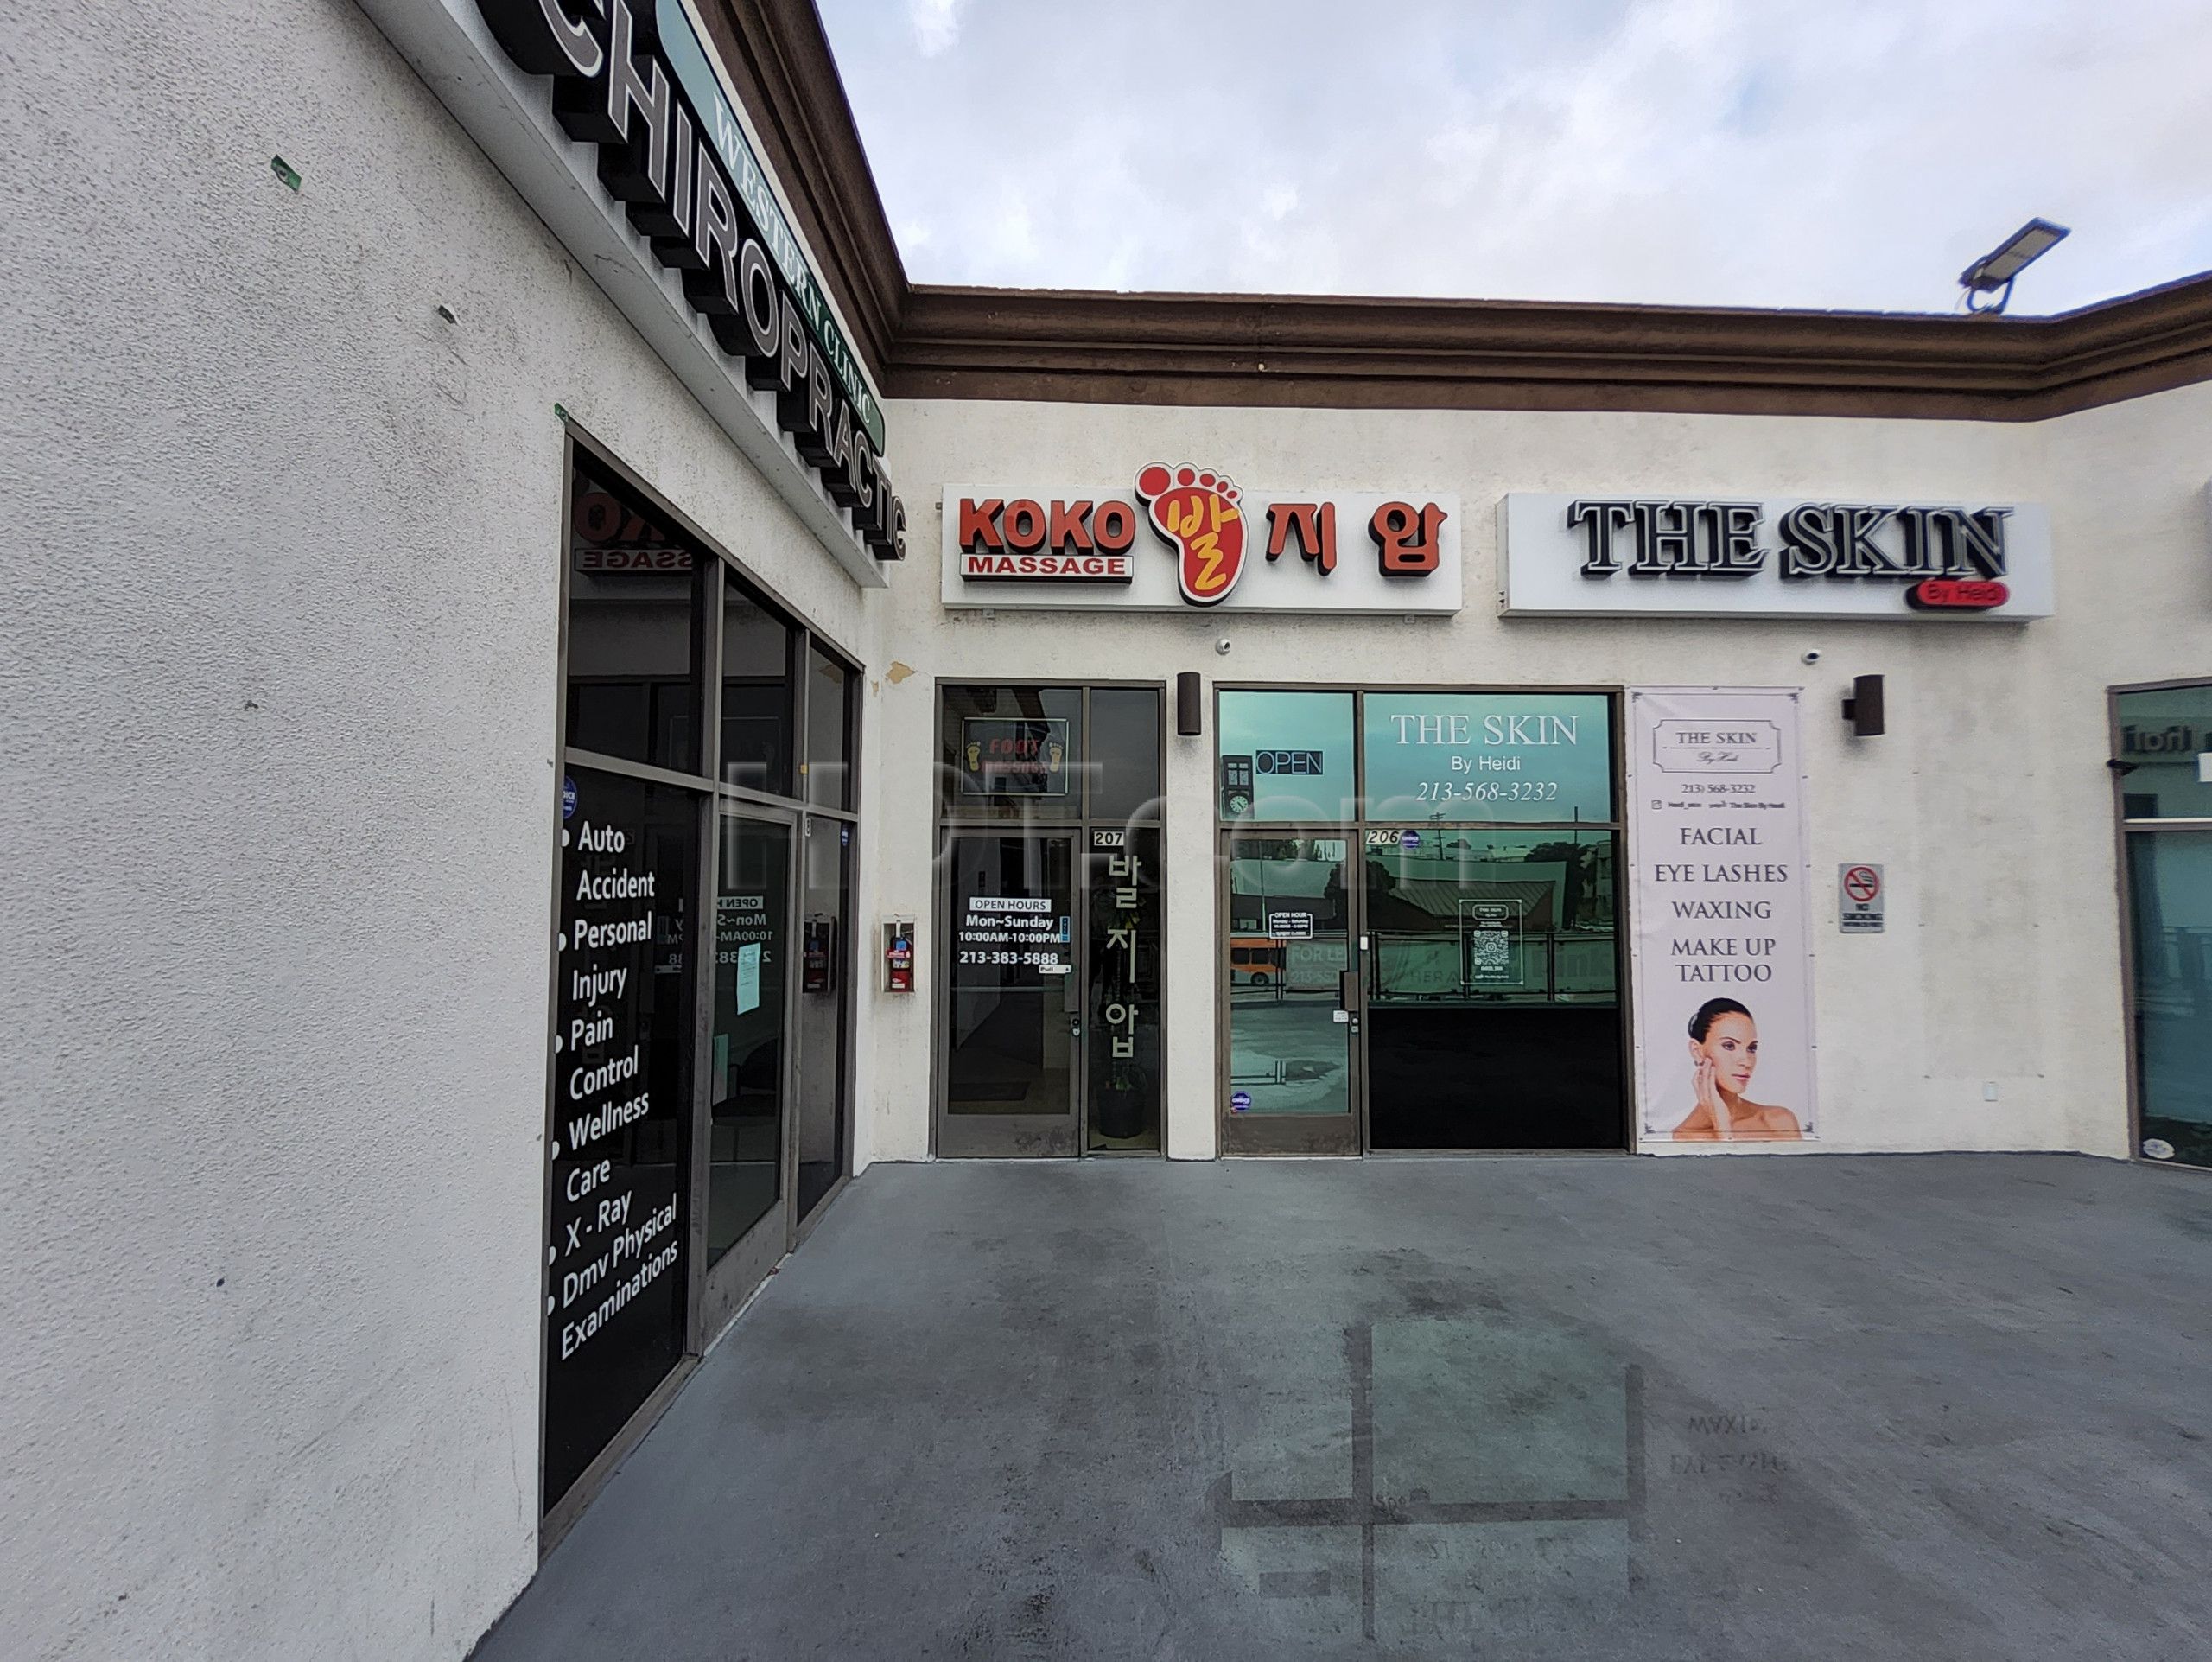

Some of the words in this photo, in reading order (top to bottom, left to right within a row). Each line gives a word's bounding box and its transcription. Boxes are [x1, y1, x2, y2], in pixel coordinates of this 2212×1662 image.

[713, 92, 823, 334] WESTERN
[823, 320, 872, 425] CLINIC
[958, 498, 1137, 556] KOKO
[1567, 498, 1770, 580] THE
[1777, 501, 2015, 582] SKIN
[967, 557, 1126, 576] MASSAGE
[1390, 714, 1471, 746] THE
[1484, 714, 1580, 746] SKIN
[1676, 731, 1711, 744] THE
[1715, 732, 1757, 745] SKIN
[989, 738, 1039, 755] FOOT
[1256, 751, 1323, 774] OPEN
[1452, 756, 1472, 775] By
[1479, 755, 1522, 771] Heidi
[1415, 782, 1558, 802] 213-568-3232
[578, 819, 626, 854] Auto
[1095, 832, 1123, 845] 207
[1368, 830, 1400, 844] 206
[1679, 827, 1763, 845] FACIAL
[1654, 863, 1694, 882] EYE
[1702, 863, 1789, 882] LASHES
[576, 867, 655, 901] Accident
[974, 900, 1006, 910] OPEN
[1007, 900, 1047, 911] HOURS
[1670, 901, 1772, 920] WAXING
[574, 911, 652, 952] Personal
[965, 914, 1054, 931] Mon~Sunday
[958, 931, 1061, 944] 10:00AM-10:00PM
[1670, 938, 1738, 956] MAKE
[1745, 938, 1777, 956] UP
[958, 950, 1059, 965] 213-383-5888
[1675, 964, 1772, 982] TATTOO
[572, 965, 628, 1007] Injury
[570, 1013, 613, 1051] Pain
[569, 1045, 639, 1100] Control
[569, 1092, 650, 1151] Wellness
[566, 1158, 611, 1203] Care
[564, 1221, 582, 1258] X
[598, 1190, 632, 1234] Ray
[563, 1258, 610, 1309] Dmv
[612, 1193, 677, 1269] Physical
[561, 1240, 679, 1362] Examinations
